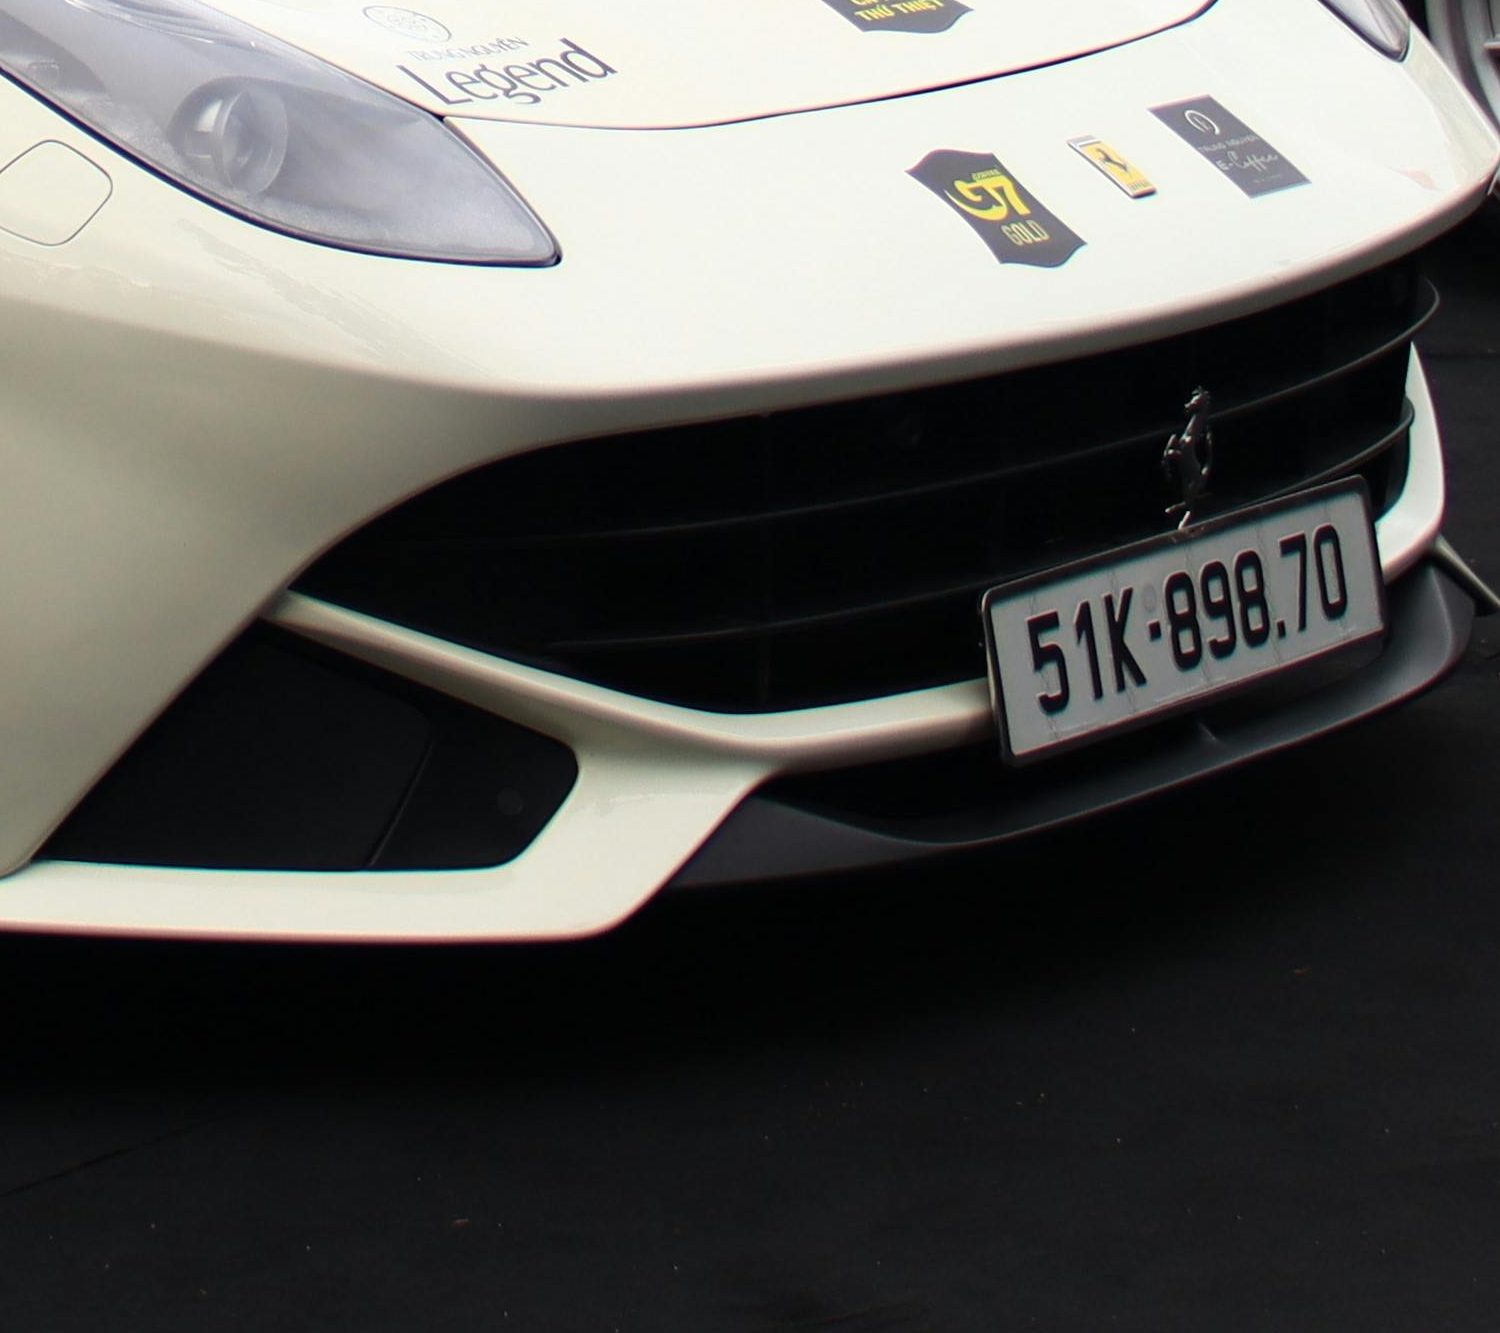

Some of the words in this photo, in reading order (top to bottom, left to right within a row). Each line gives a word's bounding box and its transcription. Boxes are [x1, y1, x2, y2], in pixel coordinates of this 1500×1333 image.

[395, 37, 619, 106] Legend
[943, 175, 1032, 221] G7
[1001, 218, 1051, 247] GOLD
[1025, 522, 1350, 715] 51K-898.70
